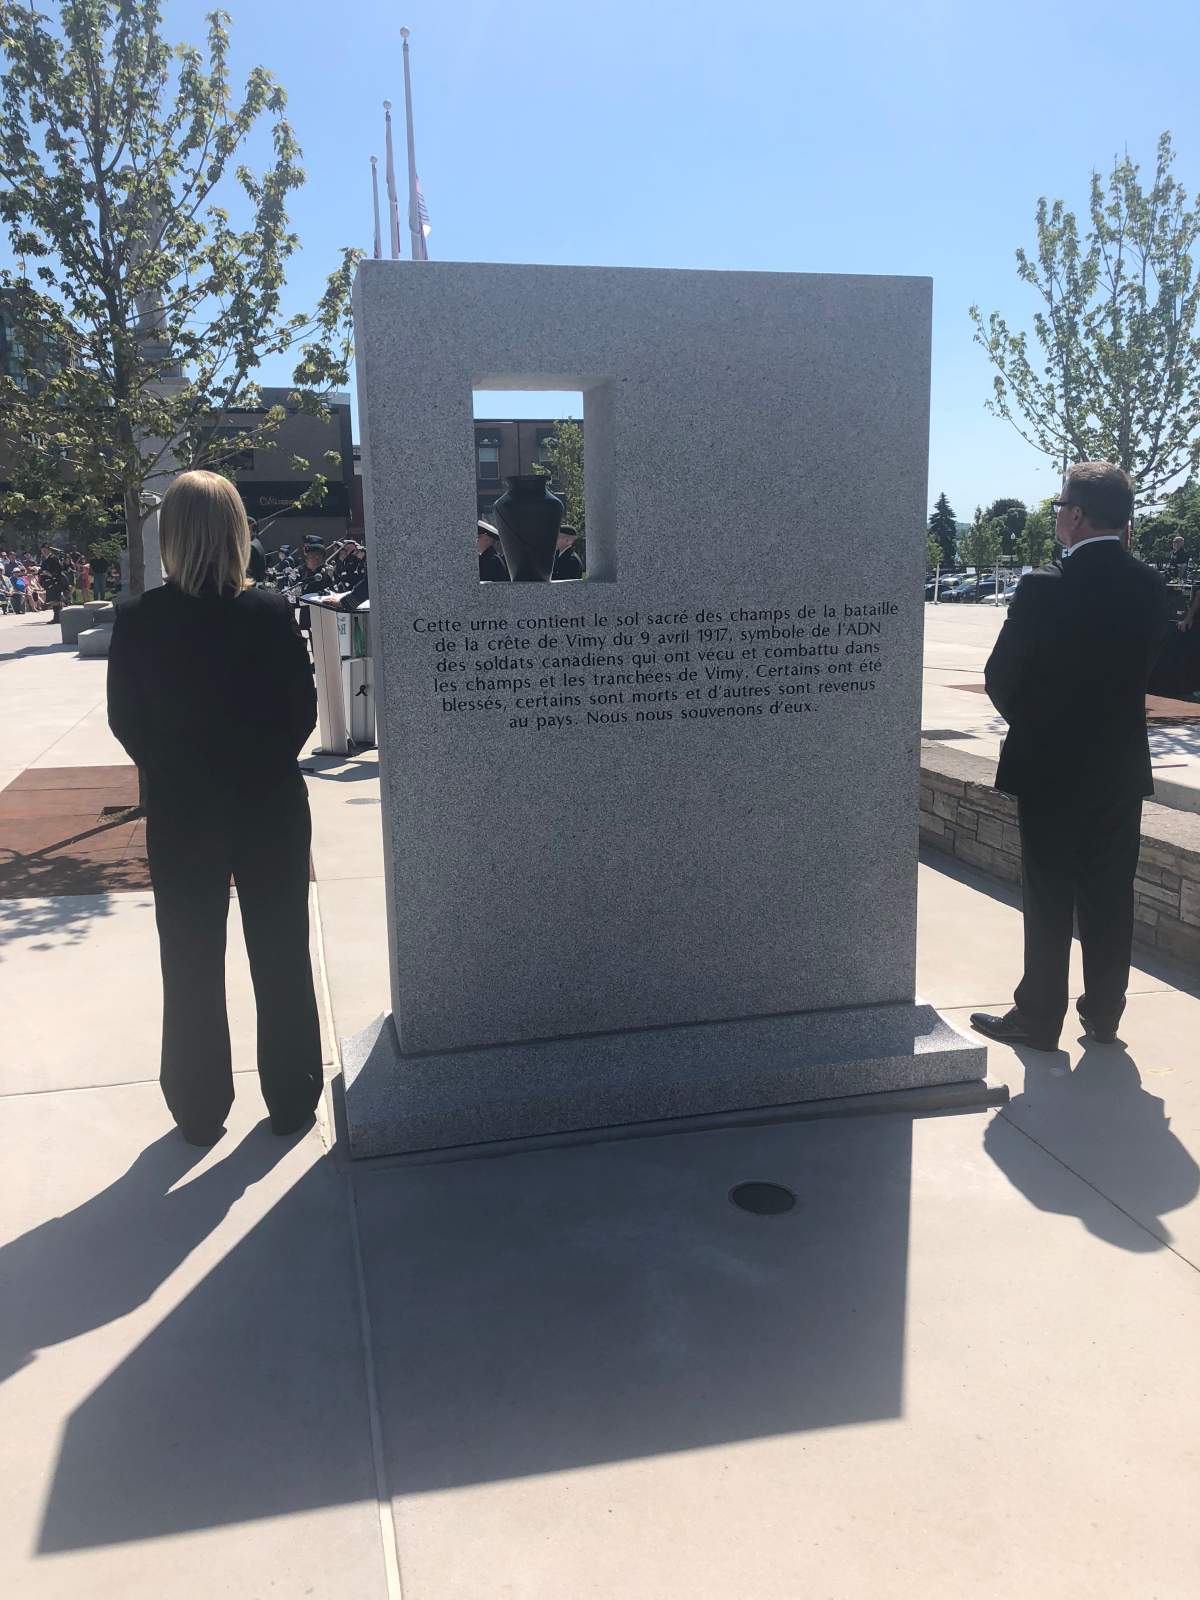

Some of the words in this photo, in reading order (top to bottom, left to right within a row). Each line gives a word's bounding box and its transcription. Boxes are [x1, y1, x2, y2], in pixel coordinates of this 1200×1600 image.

[413, 618, 461, 633] Cette
[470, 616, 508, 631] urne
[517, 614, 585, 630] contient
[594, 612, 608, 627] le
[617, 612, 638, 626] sol
[647, 610, 688, 625] sacré
[695, 609, 722, 623] des
[730, 608, 791, 624] champs
[797, 605, 816, 619] de
[824, 604, 836, 617] la
[845, 602, 898, 617] bataille
[435, 638, 456, 652] de
[465, 637, 479, 651] la
[487, 635, 530, 651] crête
[538, 634, 558, 648] de
[566, 633, 607, 650] Vimy
[613, 631, 633, 646] du
[640, 631, 650, 645] 9
[658, 630, 689, 645] avril
[699, 628, 733, 643] 1917,
[740, 625, 805, 643] symbole
[811, 624, 830, 638] de
[838, 621, 881, 636] l'ADN
[437, 657, 466, 673] des
[475, 656, 534, 671] soldats
[542, 653, 624, 669] canadiens
[632, 651, 656, 668] qui
[664, 650, 690, 663] ont
[742, 649, 757, 660] et
[764, 643, 838, 659] combattu
[845, 641, 880, 655] dans
[434, 678, 457, 693] les
[466, 676, 531, 693] champs
[540, 676, 555, 688] et
[563, 674, 585, 688] les
[678, 668, 698, 682] de
[705, 666, 749, 682] Vimy.
[756, 662, 820, 678] Certains
[828, 661, 853, 674] ont
[859, 659, 882, 672] été
[442, 696, 507, 713] blessés,
[516, 695, 581, 709] certains
[589, 692, 624, 705] sont
[632, 690, 678, 703] morts
[686, 688, 701, 700] et
[708, 685, 771, 699] d'autres
[778, 682, 811, 696] sont
[818, 680, 876, 693] revenus
[509, 717, 528, 729] au
[537, 715, 578, 731] pays.
[587, 710, 628, 725] Nous
[636, 708, 673, 722] nous
[681, 704, 763, 720] souvenons
[769, 700, 818, 715] d'eux.
